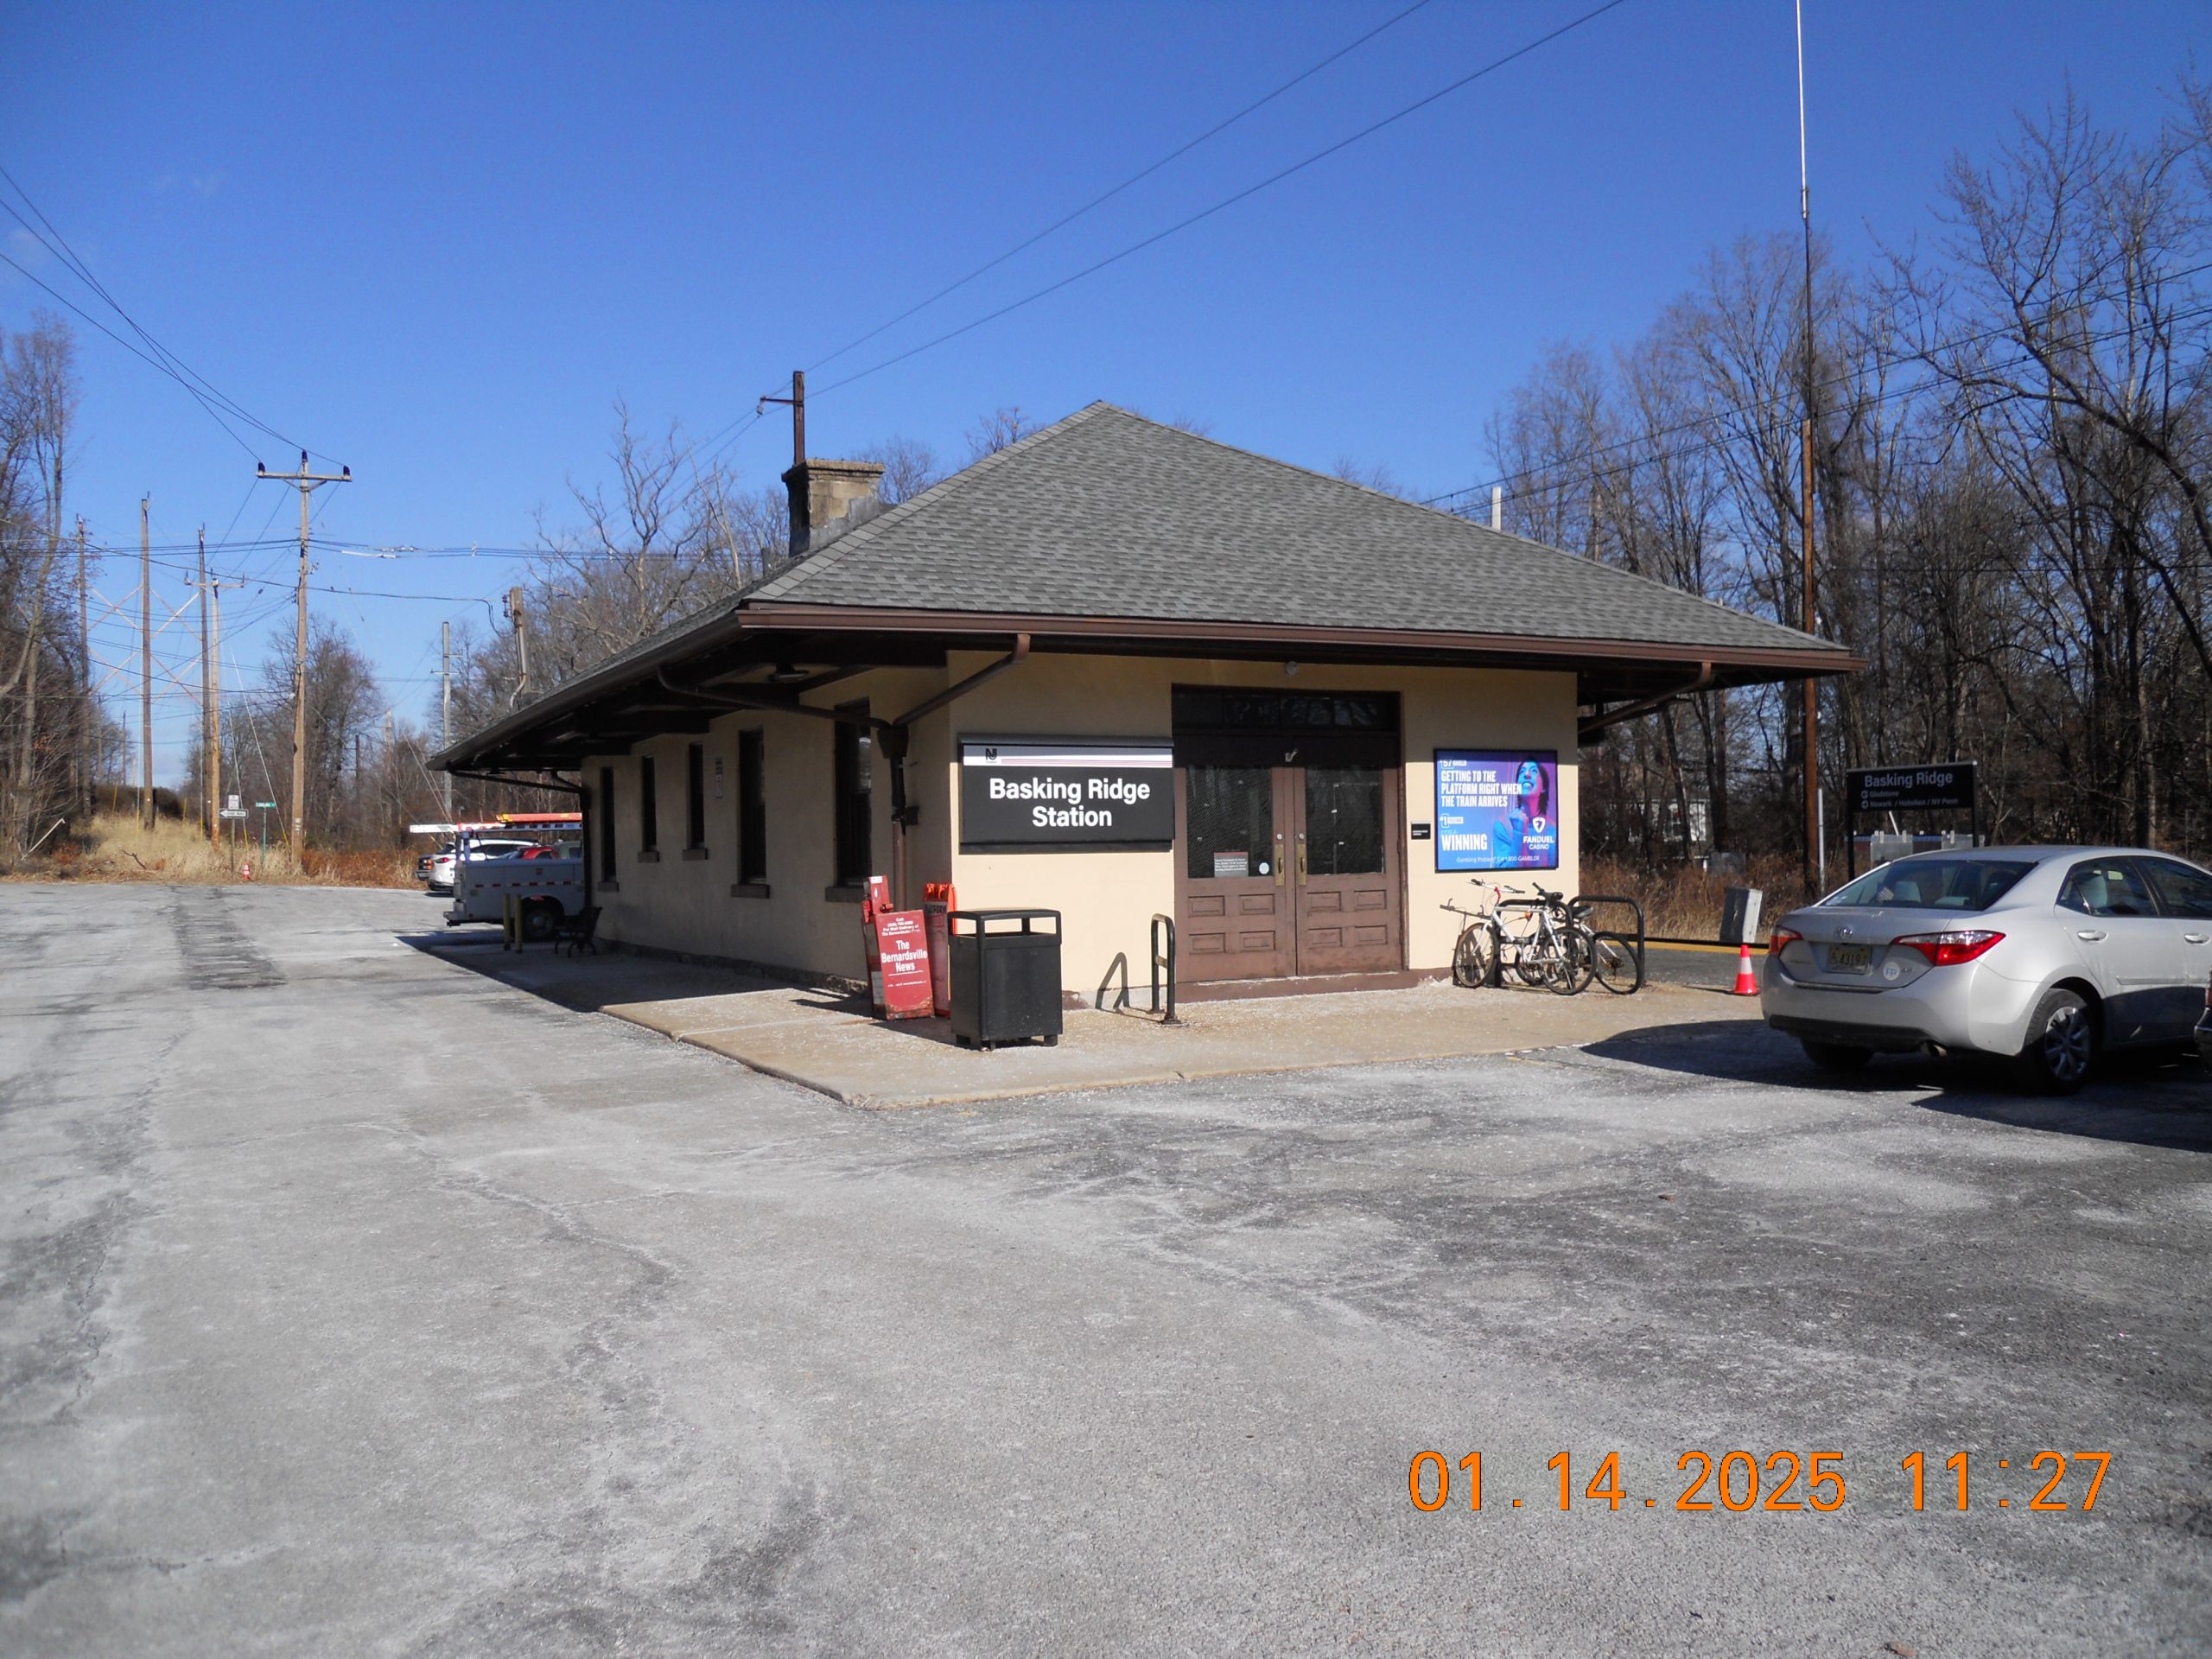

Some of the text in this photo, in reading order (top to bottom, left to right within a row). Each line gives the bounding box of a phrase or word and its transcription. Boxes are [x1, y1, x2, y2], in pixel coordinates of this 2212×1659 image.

[1441, 771, 1497, 782] GETTING TO THE
[1865, 771, 1954, 789] Basking Ridge
[989, 777, 1151, 804] Basking Ridge
[1441, 783, 1522, 795] PLATFORM RIGHT WHEN
[1441, 795, 1508, 807] THE TRAIN ARRIVES
[1032, 805, 1112, 827] Station
[1441, 834, 1488, 851] WINNING
[895, 940, 911, 950] The
[881, 949, 928, 963] Bernardsville
[895, 962, 916, 973] News
